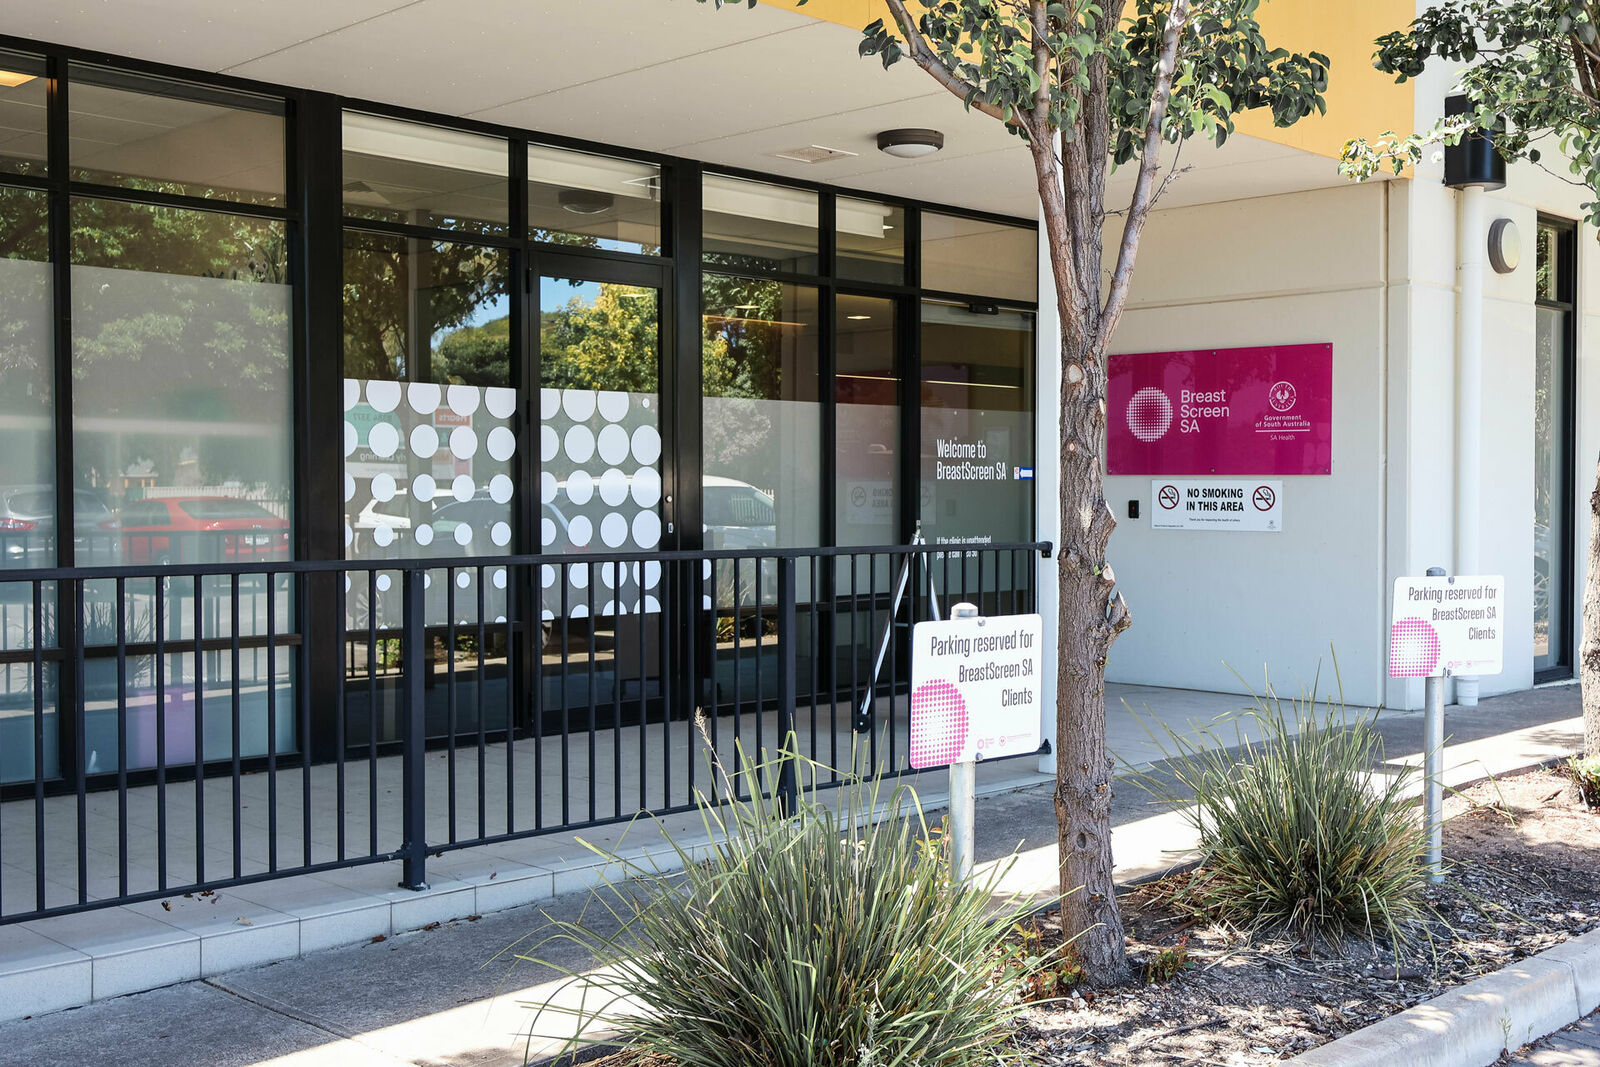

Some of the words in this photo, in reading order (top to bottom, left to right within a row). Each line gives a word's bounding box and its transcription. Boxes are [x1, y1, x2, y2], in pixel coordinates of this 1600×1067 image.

[1180, 389, 1226, 403] Breast
[1180, 404, 1230, 418] Screen
[1180, 419, 1200, 433] SA
[936, 439, 976, 459] Welcome
[977, 440, 987, 459] to
[936, 461, 994, 480] BreastScreen
[996, 463, 1007, 480] SA
[1187, 488, 1200, 498] NO
[1202, 488, 1244, 498] SMOKING
[1186, 501, 1196, 511] IN
[1197, 501, 1218, 511] THIS
[1220, 501, 1245, 511] AREA
[1408, 586, 1443, 603] Parking
[1444, 585, 1483, 601] reserved
[1485, 584, 1497, 600] for
[1432, 606, 1485, 621] BreastScreen
[1486, 605, 1497, 619] SA
[1468, 626, 1496, 640] Clients
[930, 634, 970, 658] Parking
[973, 630, 1017, 653] reserved
[1019, 629, 1034, 649] for
[958, 661, 1020, 683] BreastScreen
[1022, 658, 1033, 677] SA
[1001, 687, 1033, 707] Clients
